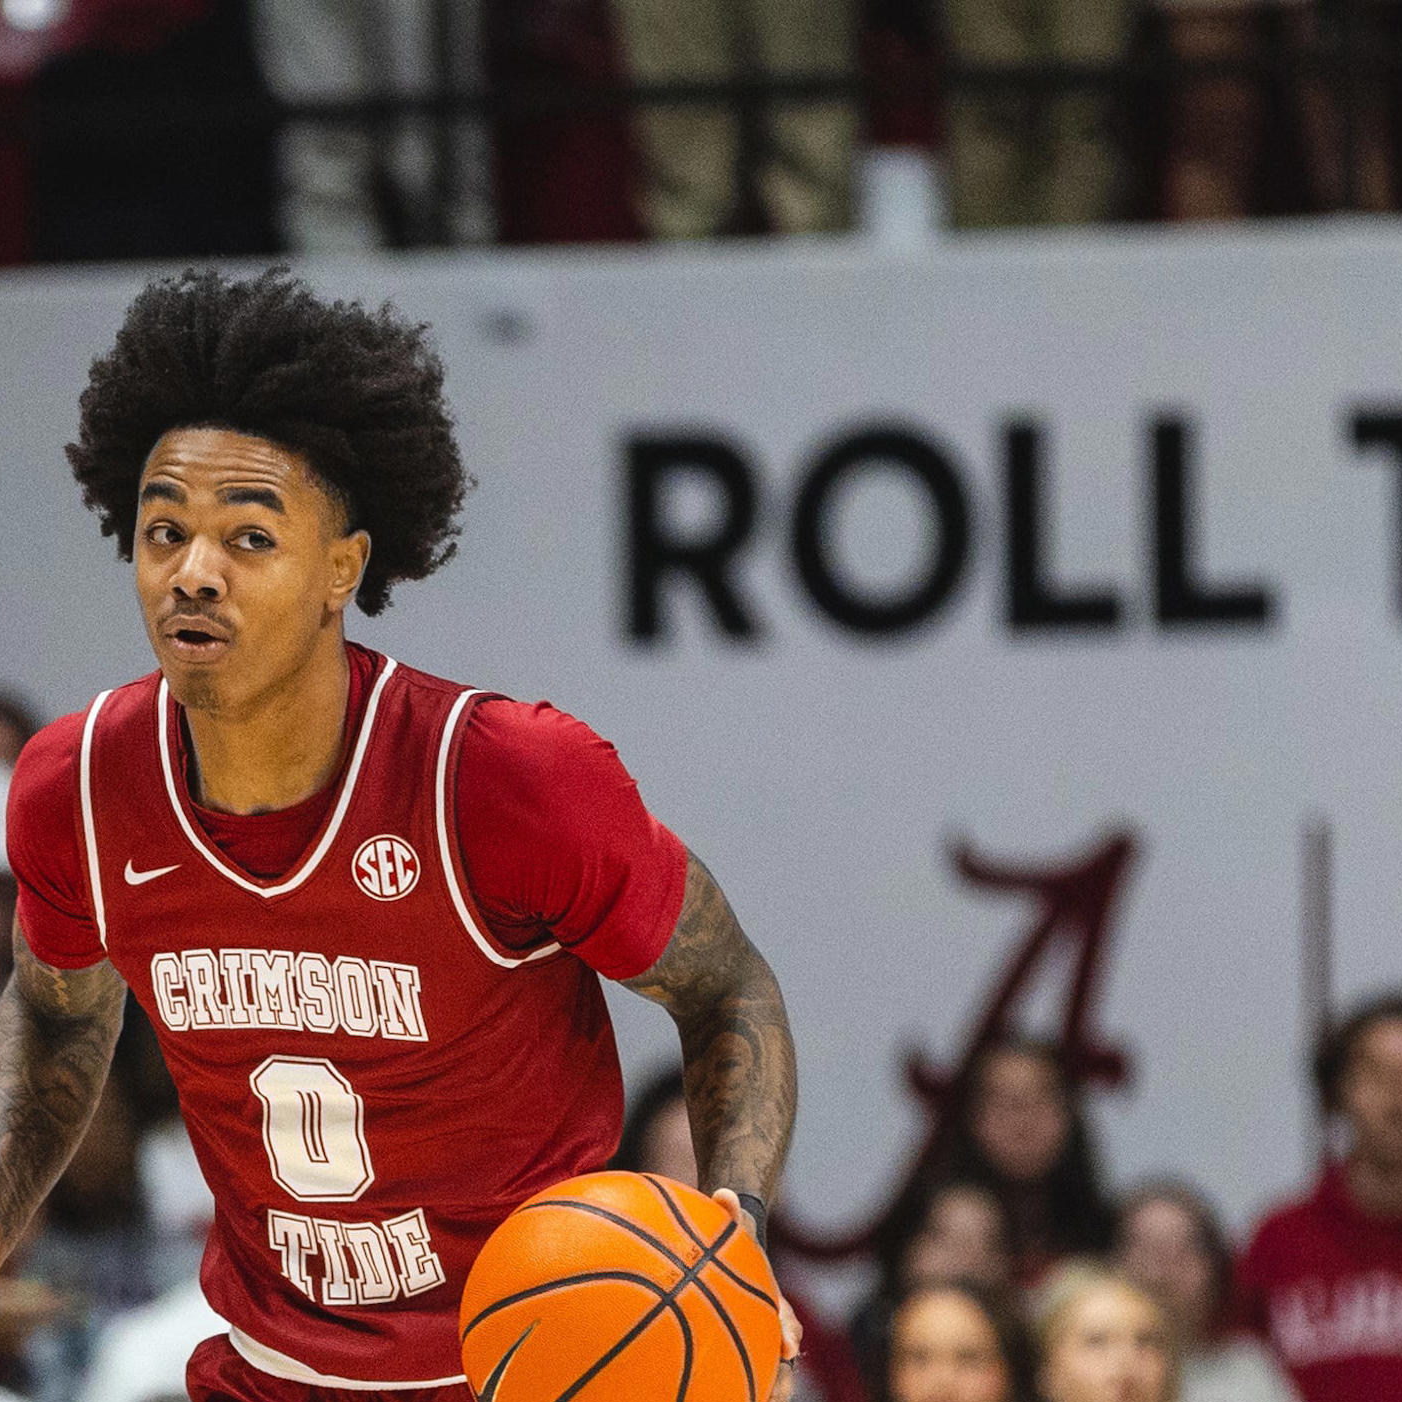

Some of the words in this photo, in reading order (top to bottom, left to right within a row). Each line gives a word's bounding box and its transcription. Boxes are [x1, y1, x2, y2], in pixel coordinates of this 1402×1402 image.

[614, 410, 1279, 652] ROLL
[357, 840, 416, 896] SEC
[150, 948, 429, 1042] CRIMSON
[249, 1054, 375, 1202] 0
[267, 1207, 446, 1305] TIDE
